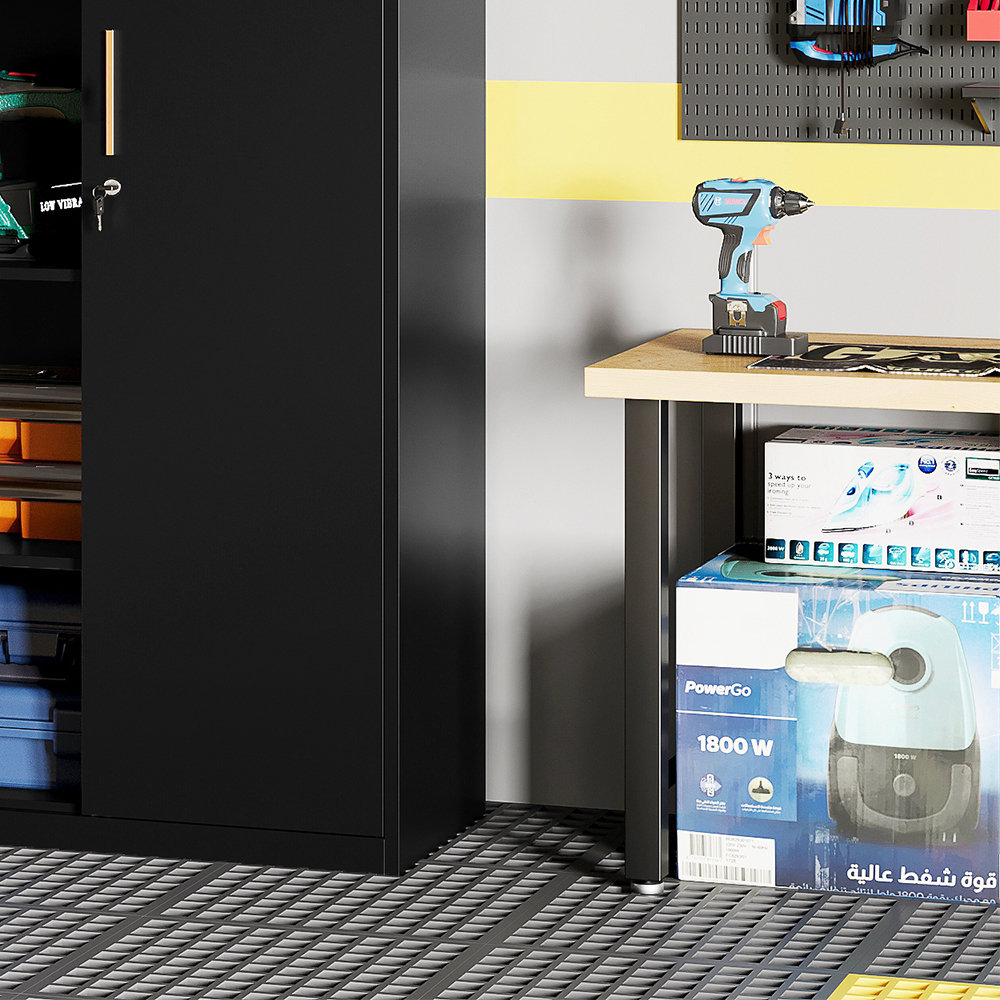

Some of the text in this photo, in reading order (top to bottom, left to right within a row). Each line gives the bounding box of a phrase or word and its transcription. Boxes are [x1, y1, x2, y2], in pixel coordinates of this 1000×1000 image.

[40, 200, 56, 212] LOW
[768, 472, 773, 480] 3
[774, 474, 795, 482] ways
[768, 481, 786, 489] speed
[684, 680, 752, 697] PowerGo
[697, 735, 774, 757] 1800 W
[846, 864, 997, 893] قوة شفط عالية
